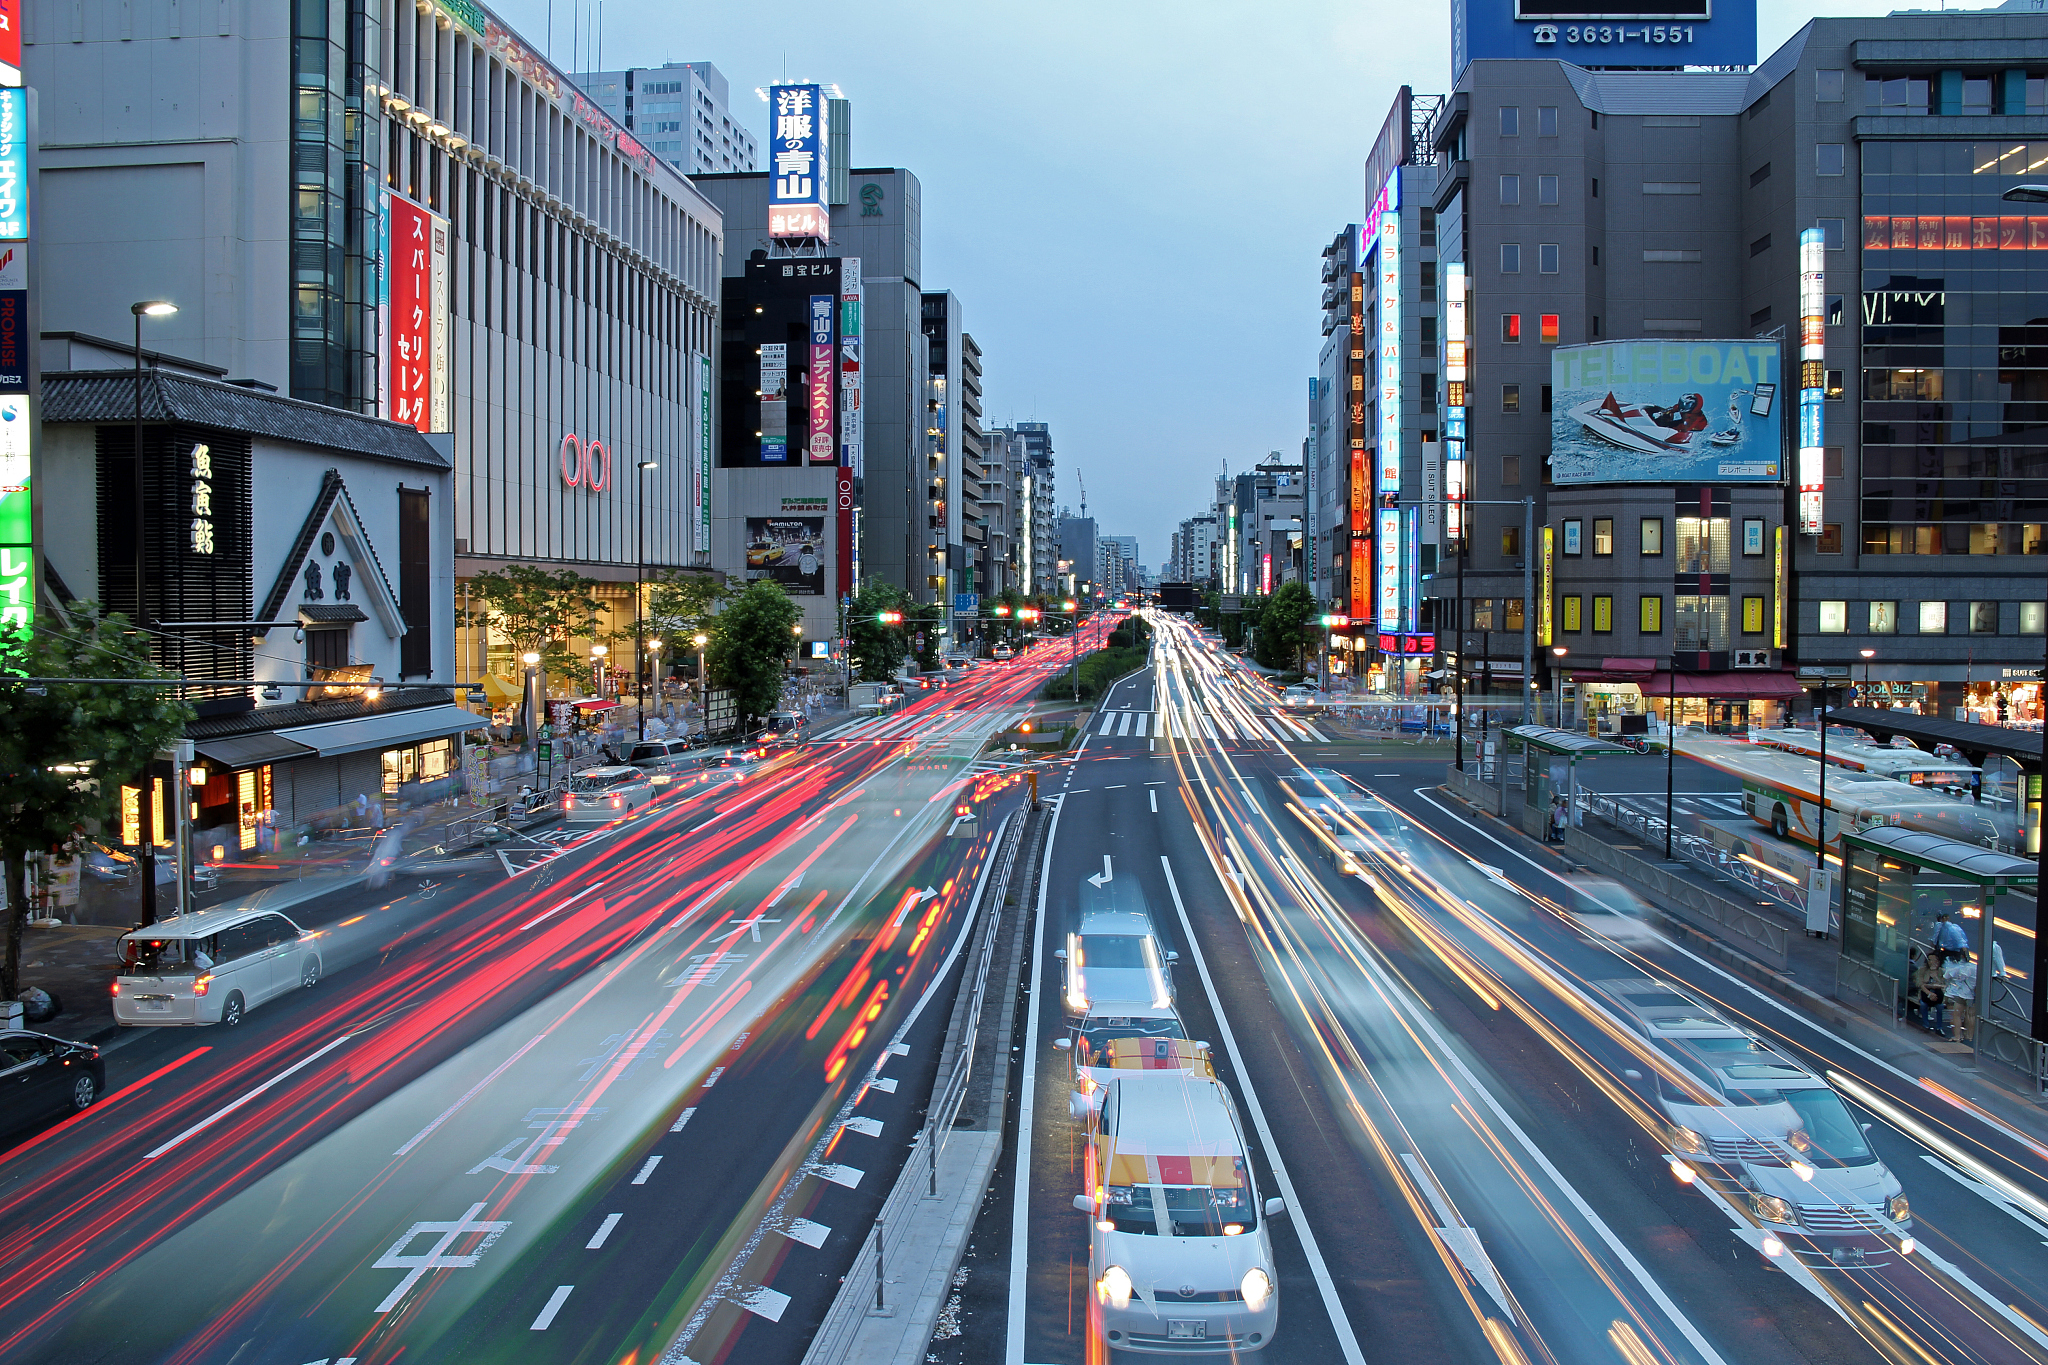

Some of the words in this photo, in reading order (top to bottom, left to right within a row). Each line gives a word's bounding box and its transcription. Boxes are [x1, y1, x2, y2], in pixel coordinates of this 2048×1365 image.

[1566, 25, 1694, 43] 3631-1551
[775, 90, 814, 199] 洋服の青山
[860, 207, 883, 216] JRA
[771, 213, 816, 232] 当ビル
[783, 264, 833, 277] 国宝ビル
[412, 215, 424, 423] スパークリング
[1, 298, 16, 366] PROMISE
[398, 333, 410, 421] セール
[1555, 346, 1777, 389] TELEBOAT
[811, 445, 832, 453] 販売中
[813, 436, 830, 444] 好評
[191, 443, 214, 555] 魚寅鮨
[1383, 520, 1397, 620] カラオケ館
[0, 548, 27, 629] レイク
[304, 560, 352, 600] 魚寅
[815, 642, 826, 655] P
[1405, 636, 1435, 652] カラ
[1855, 684, 1886, 694] COOL
[1892, 684, 1912, 694] BIZ
[543, 731, 549, 739] 8
